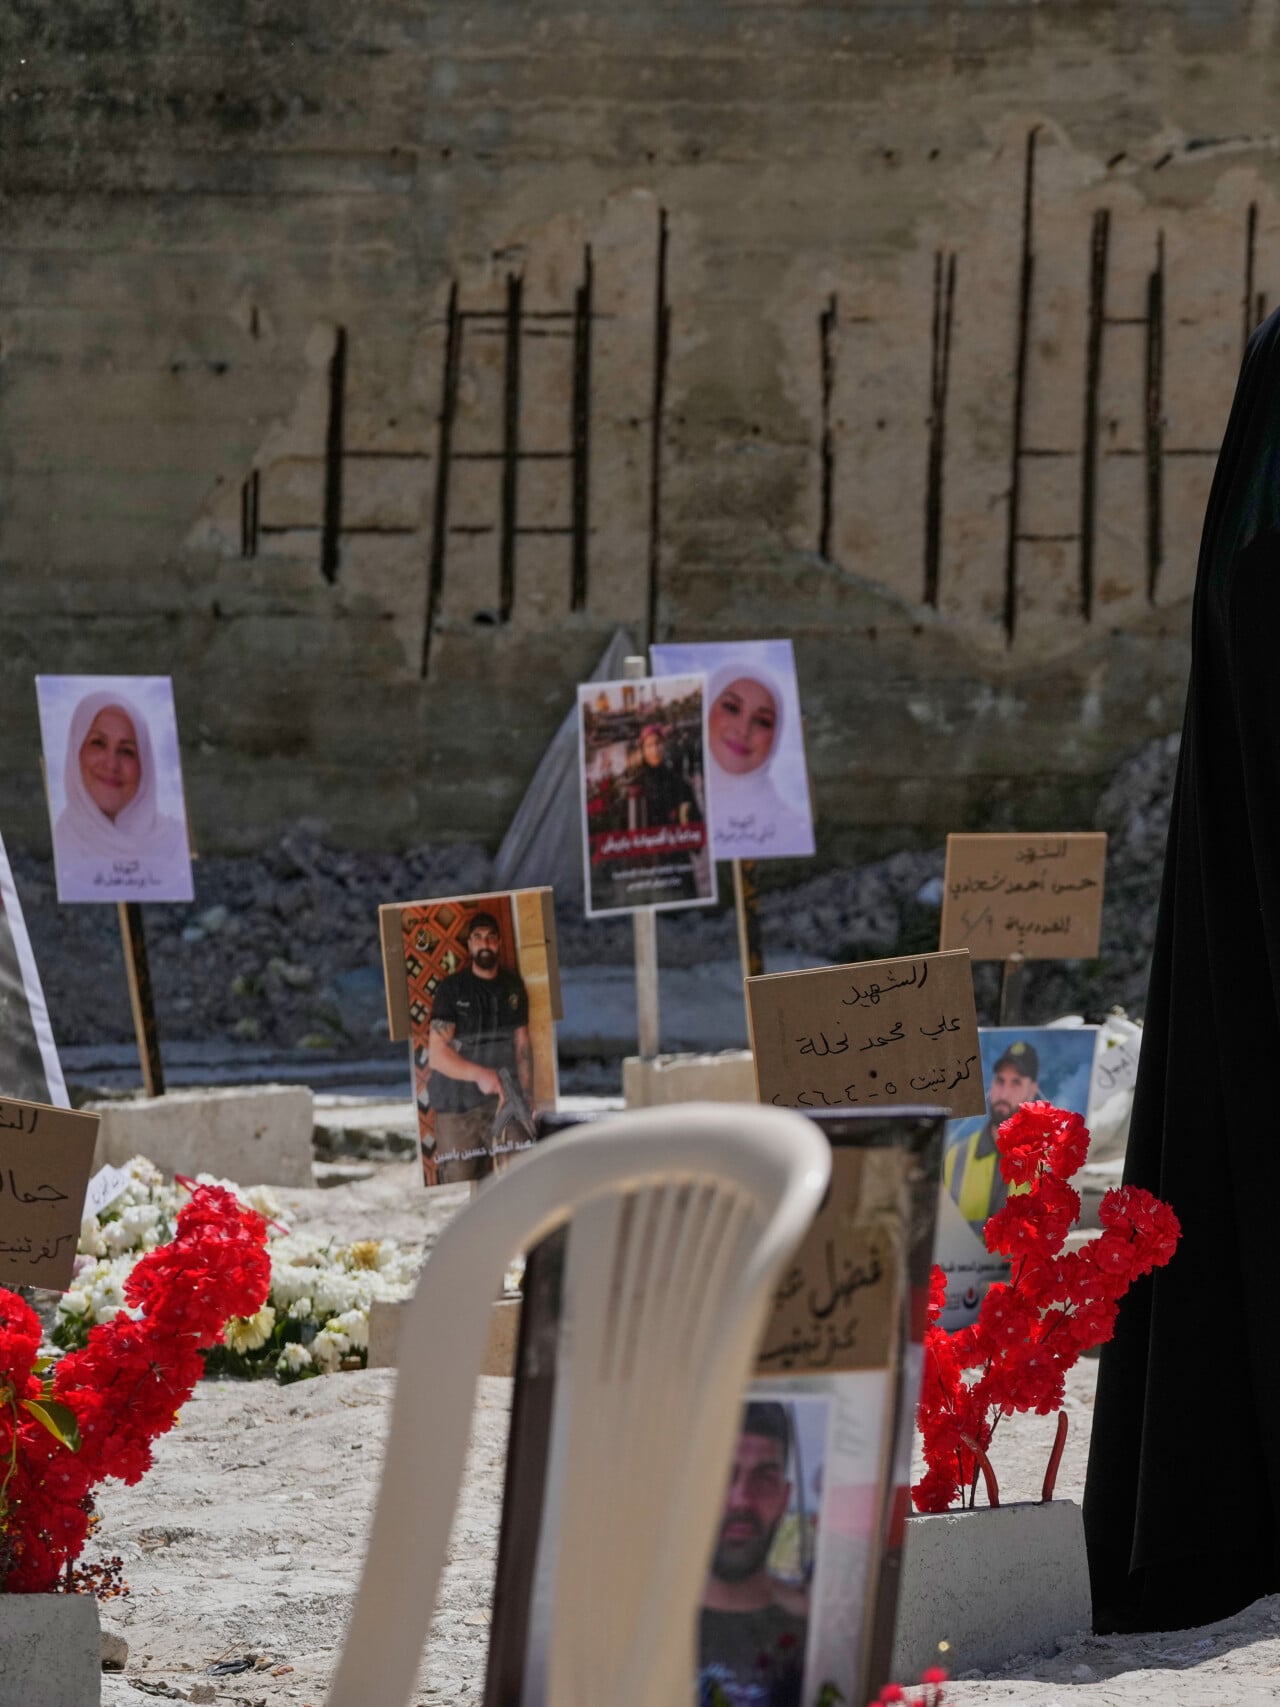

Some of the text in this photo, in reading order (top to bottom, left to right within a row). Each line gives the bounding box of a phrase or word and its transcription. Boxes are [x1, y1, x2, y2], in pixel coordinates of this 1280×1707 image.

[842, 961, 928, 1008] الشهيد
[859, 1022, 906, 1052] محمد
[919, 1016, 961, 1041] علي
